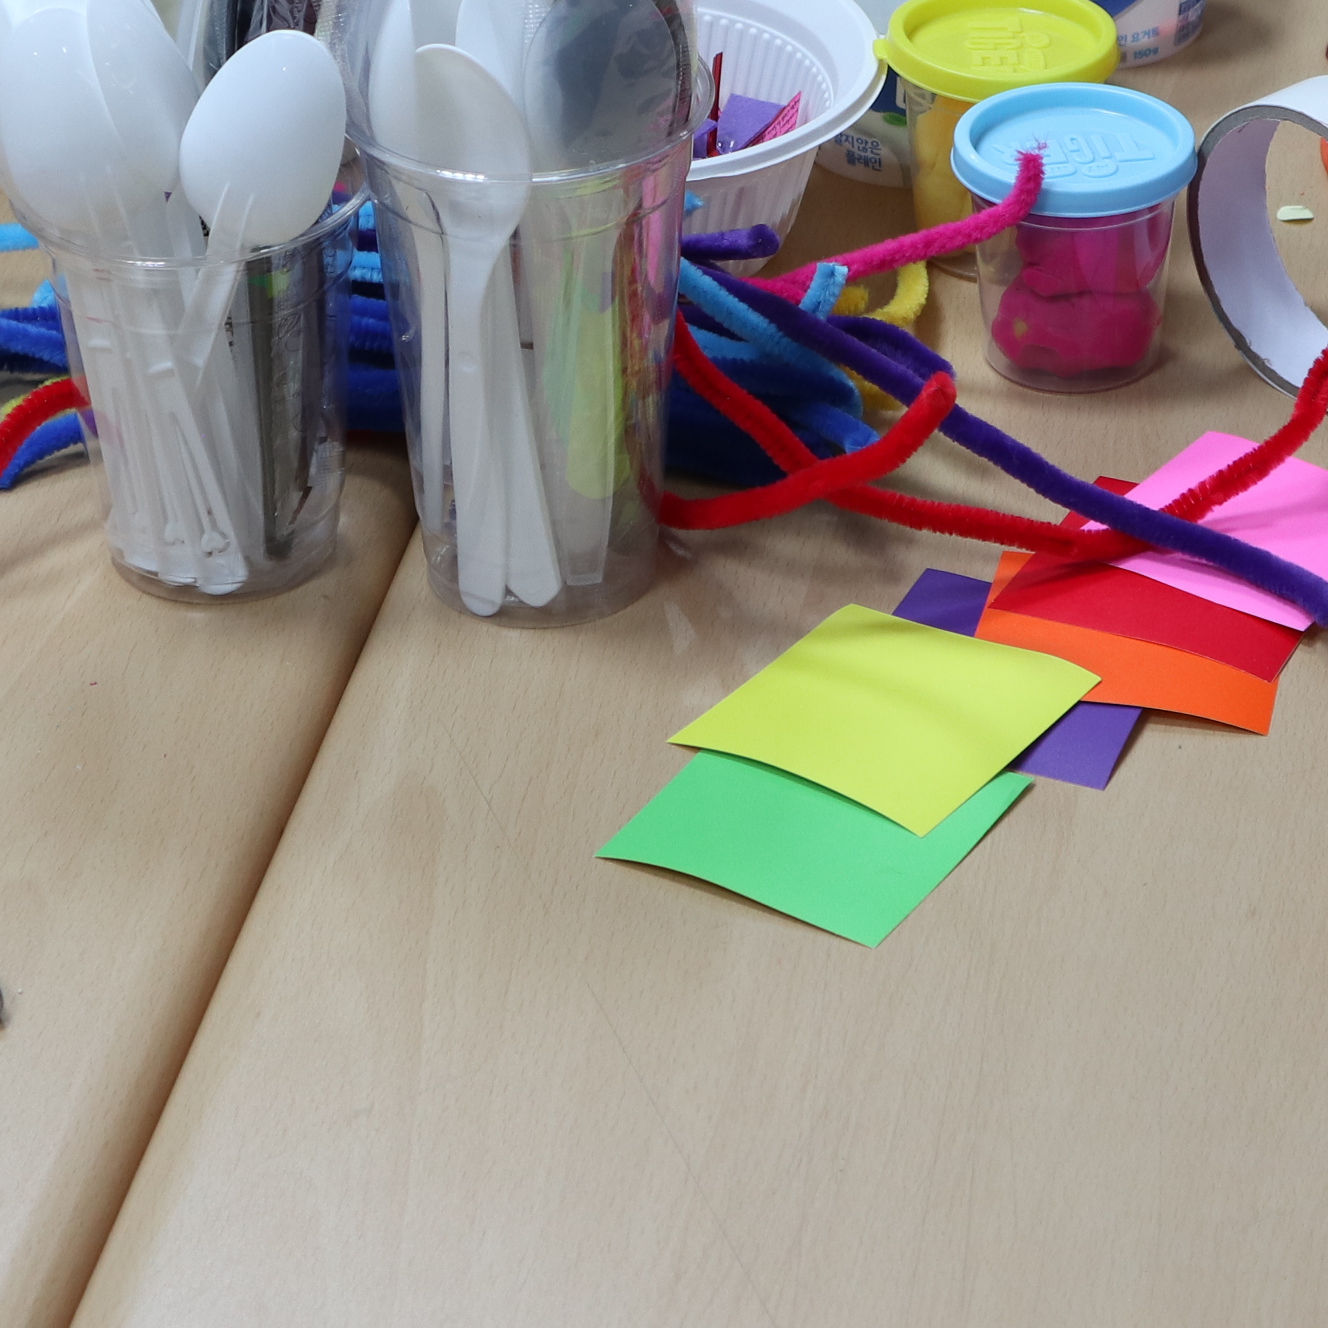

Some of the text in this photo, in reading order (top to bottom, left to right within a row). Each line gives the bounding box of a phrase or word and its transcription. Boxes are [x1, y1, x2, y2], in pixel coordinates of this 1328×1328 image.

[1131, 26, 1160, 43] 요거트
[1132, 46, 1159, 61] 150g
[846, 149, 883, 172] 플레인
